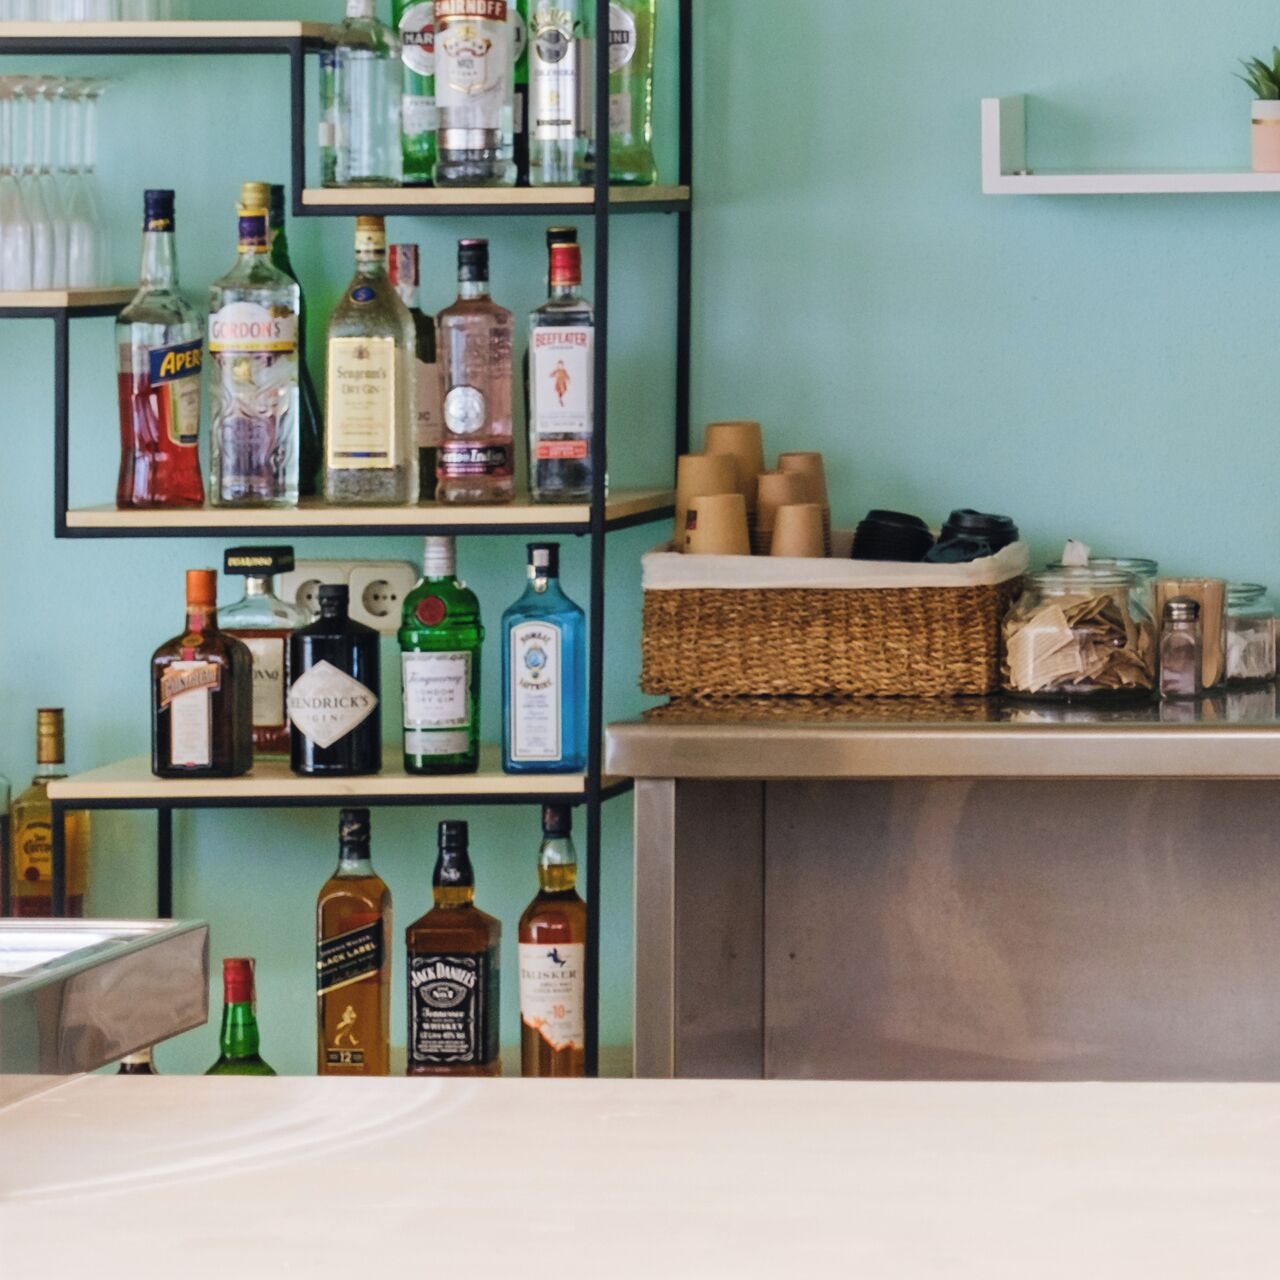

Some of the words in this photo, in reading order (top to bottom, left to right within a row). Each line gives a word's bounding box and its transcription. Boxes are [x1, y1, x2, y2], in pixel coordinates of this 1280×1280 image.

[212, 320, 282, 339] GORDON'S
[535, 332, 588, 348] BEEFEATER
[346, 941, 377, 958] LABEL
[552, 1003, 566, 1020] 10
[339, 1051, 353, 1064] 12
